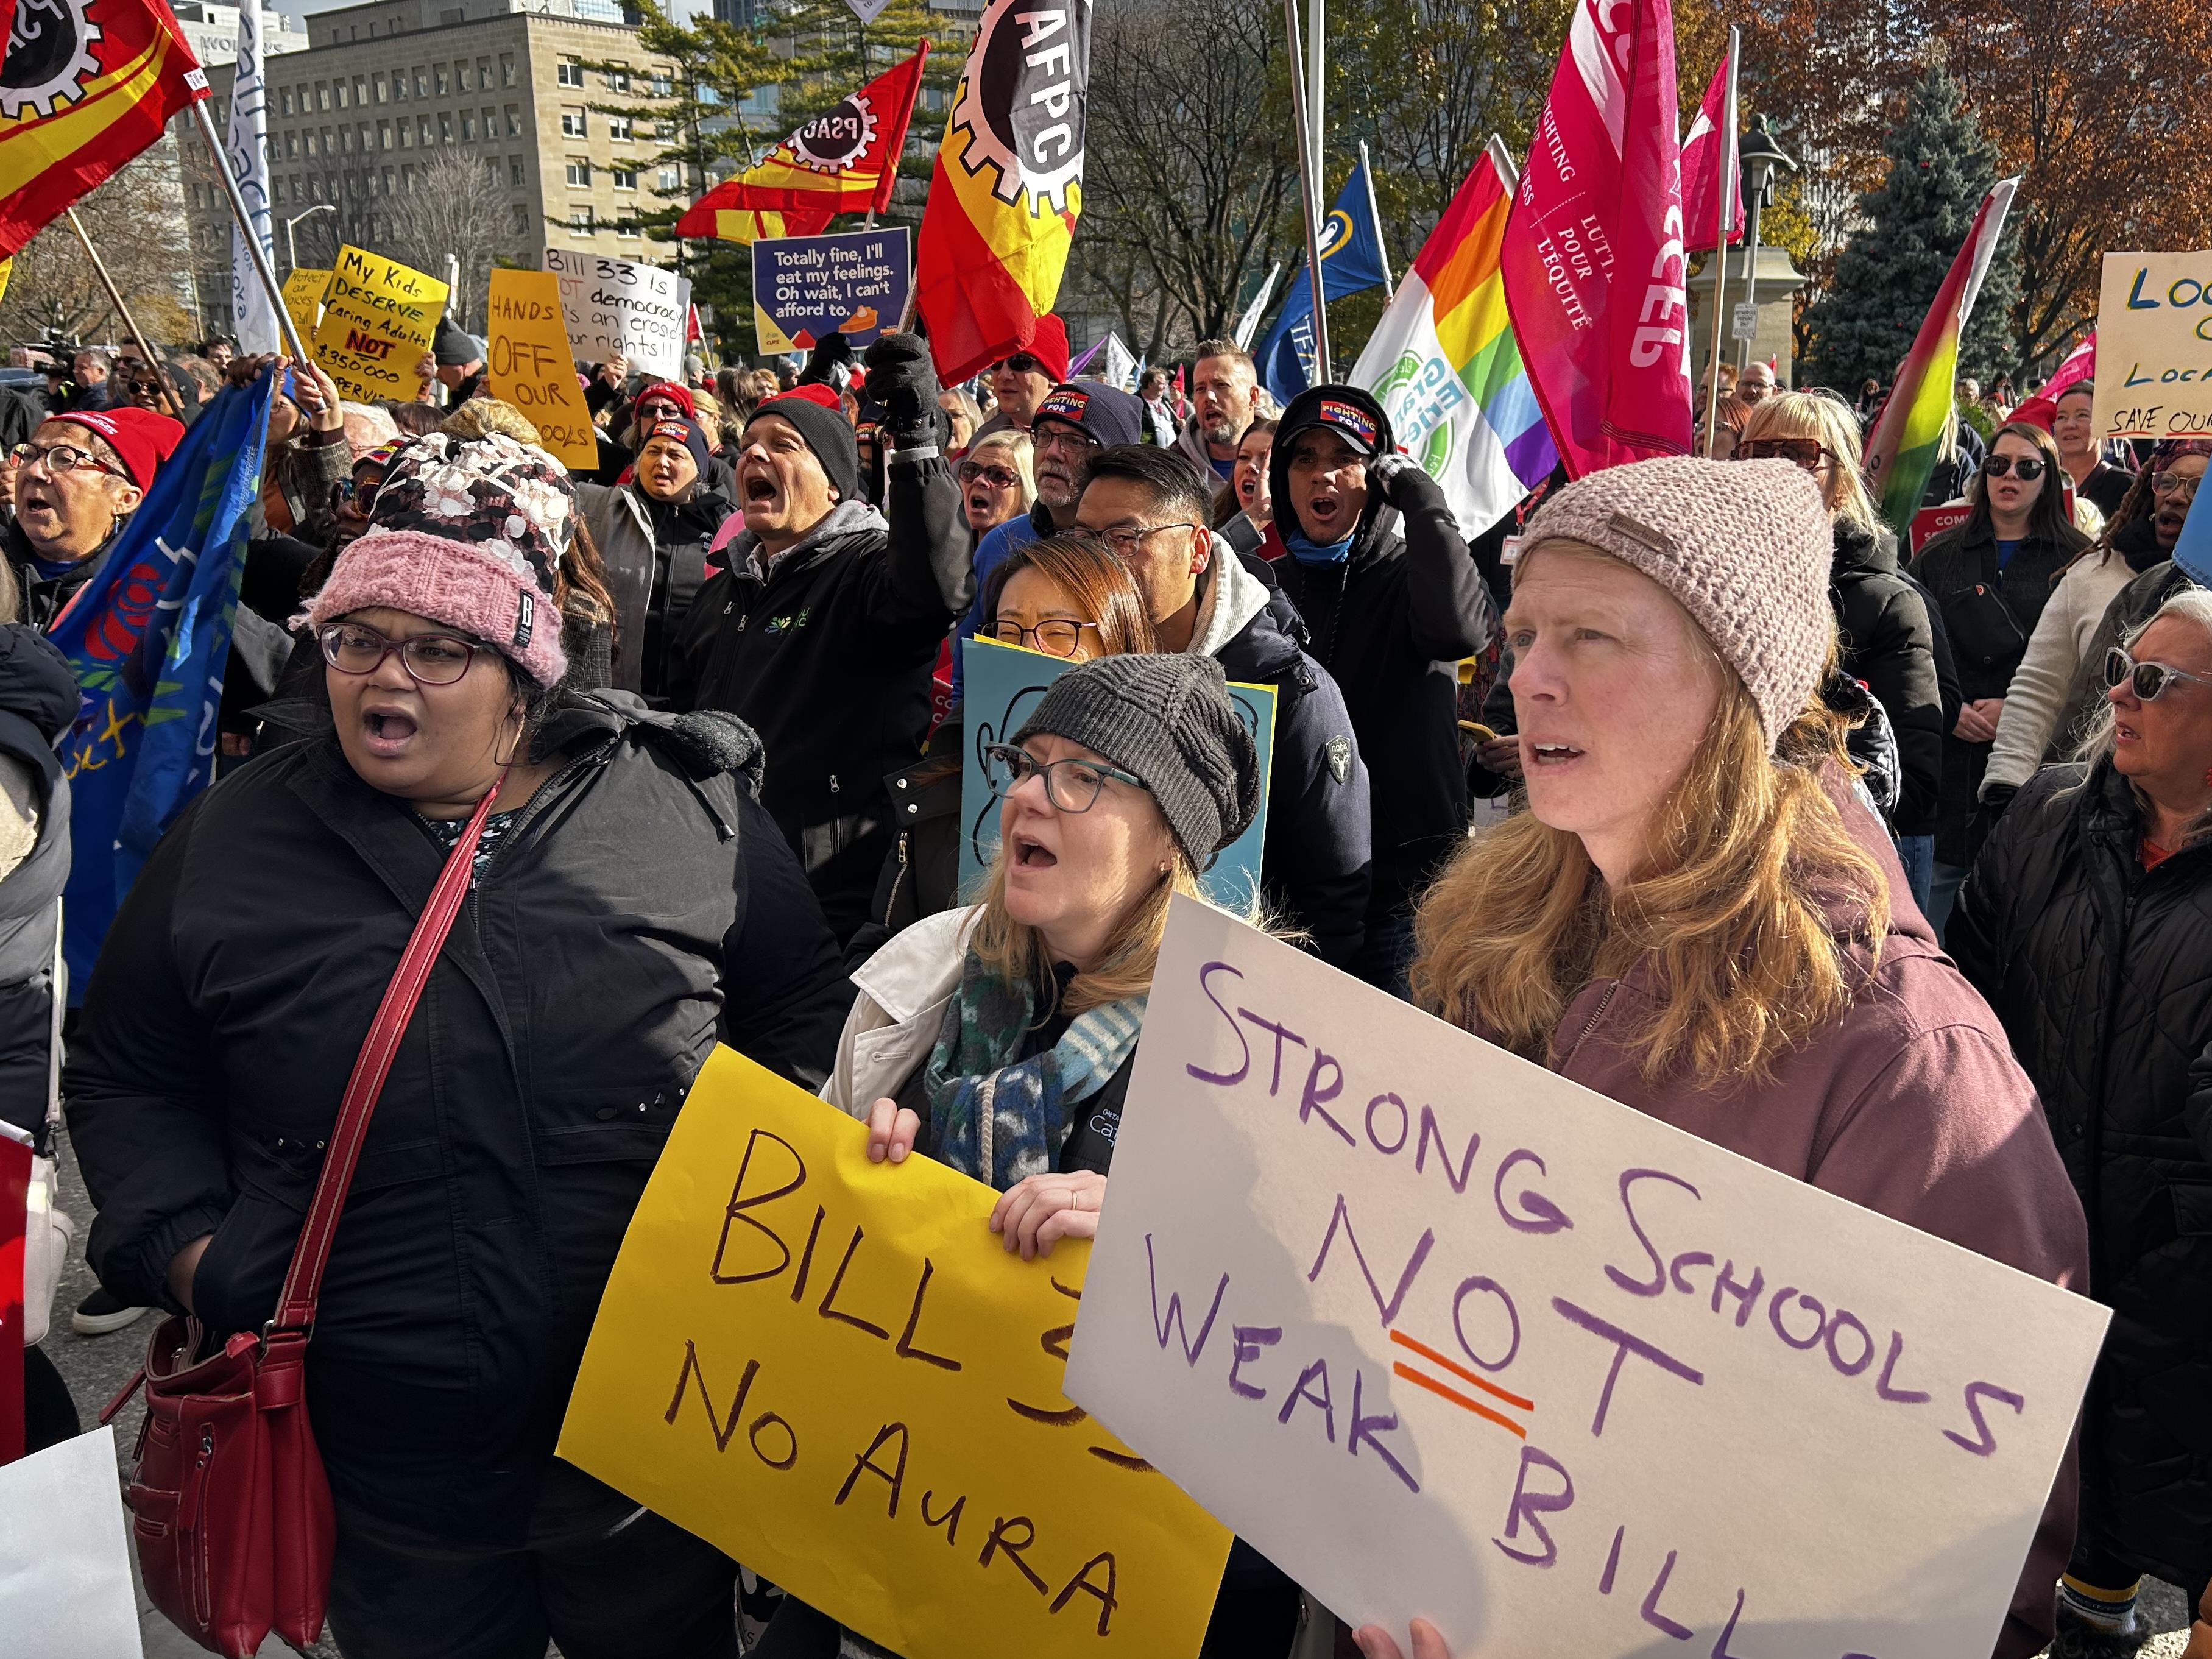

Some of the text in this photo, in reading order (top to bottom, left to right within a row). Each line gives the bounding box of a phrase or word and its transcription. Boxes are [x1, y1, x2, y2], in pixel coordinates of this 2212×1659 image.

[1014, 10, 1071, 163] AFPC
[546, 249, 585, 276] Bill
[596, 260, 638, 285] 33
[774, 242, 883, 268] Totally fine, I'll
[1558, 227, 1592, 280] POUR
[343, 252, 422, 297] My Kids
[560, 278, 584, 299] OT
[776, 264, 894, 285] eat my feelings.
[336, 277, 423, 322] DESERVE
[776, 281, 890, 301] Oh wait, I can't
[327, 299, 371, 331] Caring
[492, 295, 554, 320] HANDS
[590, 288, 683, 331] democracy
[776, 302, 851, 319] afford to.
[592, 312, 620, 328] an
[631, 317, 685, 343] erosion
[345, 328, 397, 359] NOT
[493, 335, 556, 377] OFF
[595, 332, 673, 366] rights!!
[515, 383, 570, 406] OUR
[1047, 404, 1067, 413] FOR
[1322, 405, 1376, 431] FIGHTING
[1338, 415, 1360, 432] FOR
[2107, 406, 2163, 433] SAVE
[1186, 961, 2024, 1457] STRONG SCHOOLS
[710, 1128, 962, 1371] BILL
[1308, 1192, 1704, 1437] NOT
[1145, 1233, 1421, 1493] WEAK
[1491, 1446, 1745, 1659] BILL
